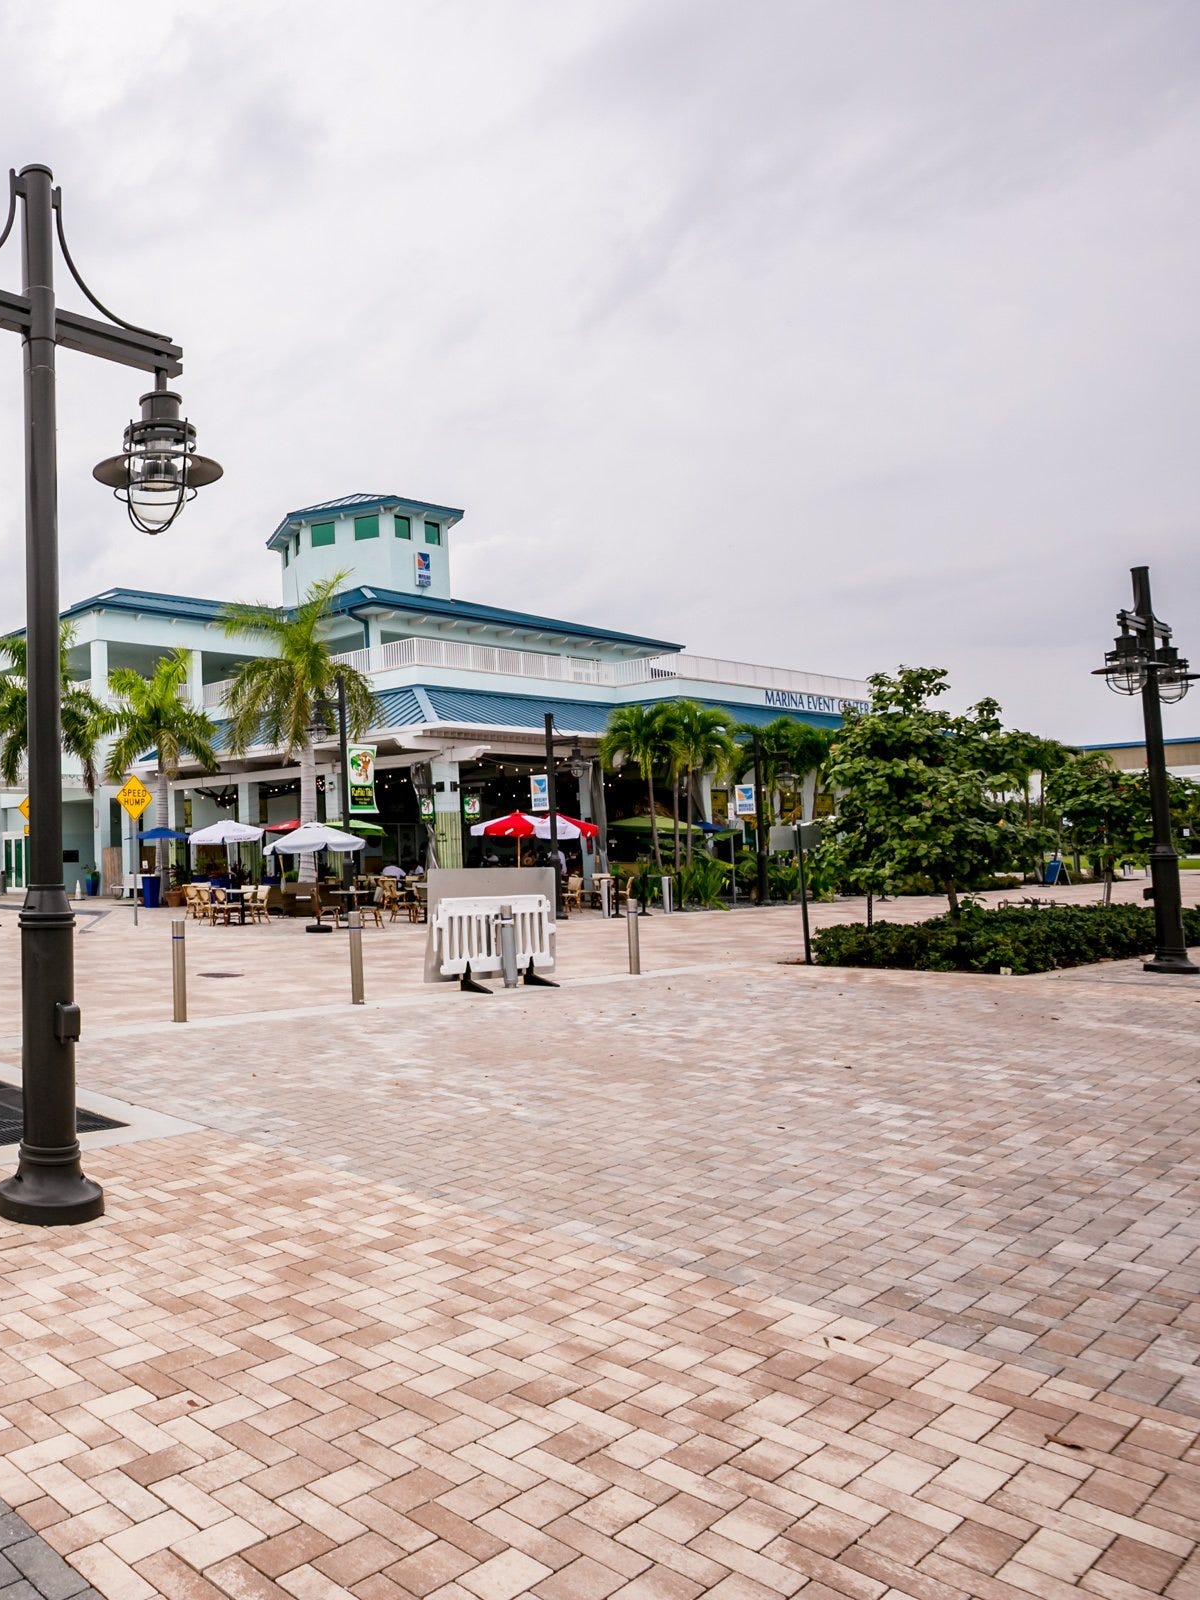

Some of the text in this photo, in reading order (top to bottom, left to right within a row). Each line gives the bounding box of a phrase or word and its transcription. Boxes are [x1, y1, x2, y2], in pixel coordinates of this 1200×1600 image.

[765, 690, 805, 709] MARINA
[807, 695, 836, 713] EVENT
[122, 788, 147, 798] SPEED
[124, 798, 145, 806] HUMP
